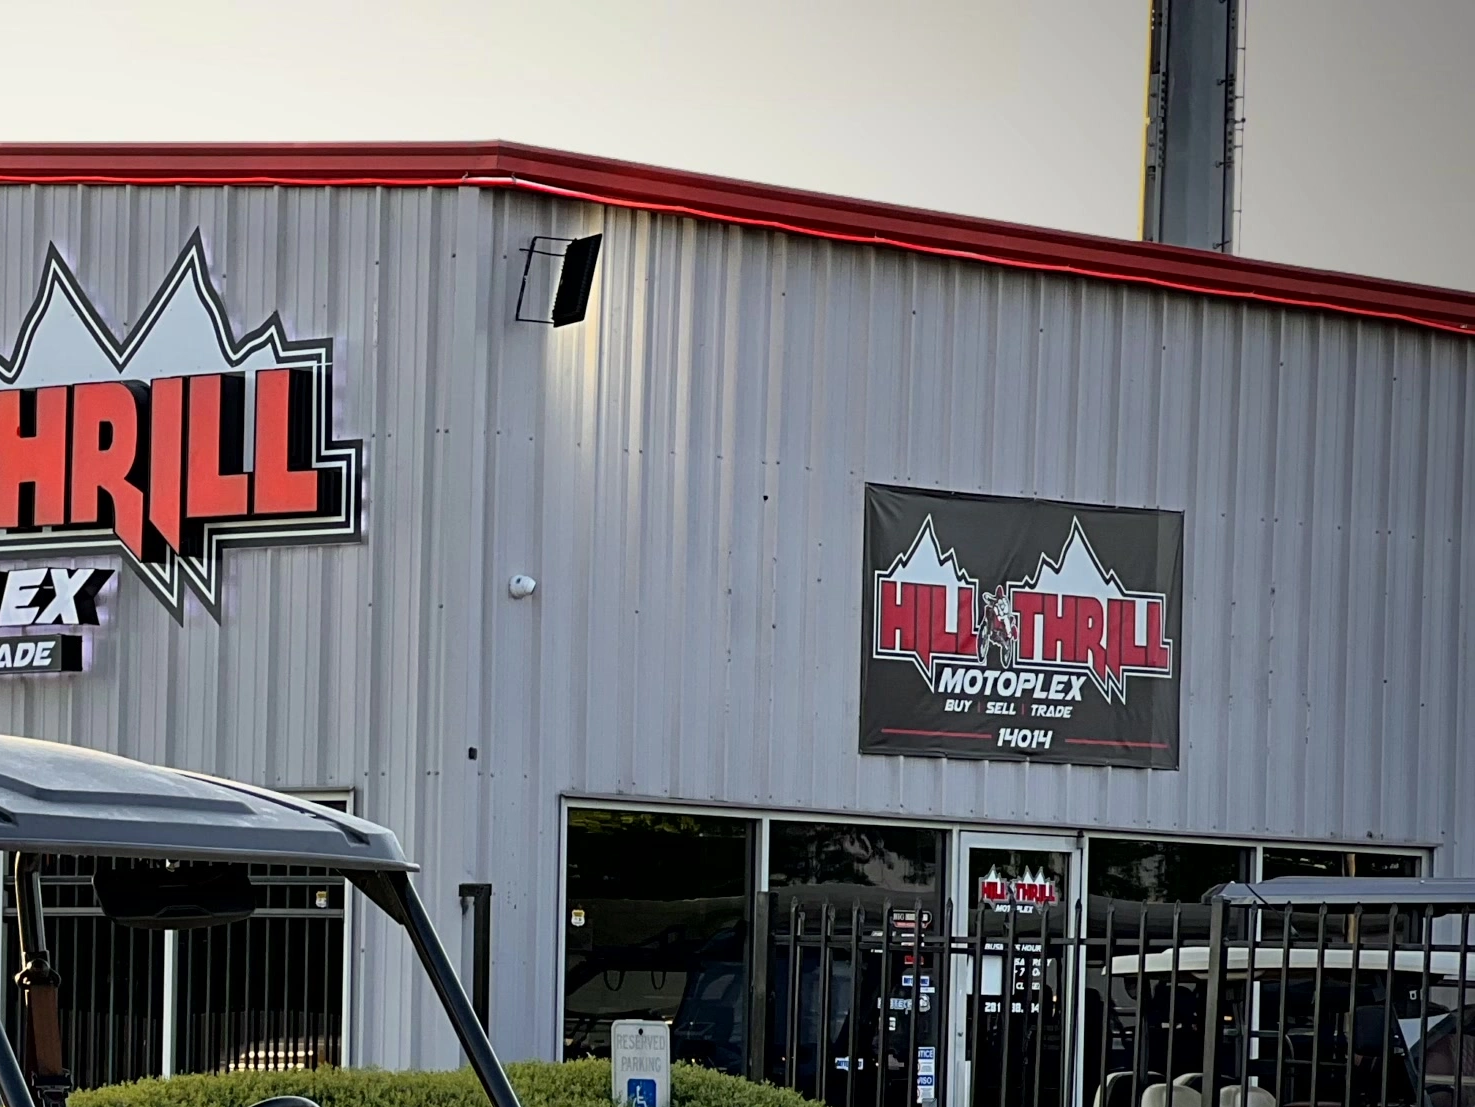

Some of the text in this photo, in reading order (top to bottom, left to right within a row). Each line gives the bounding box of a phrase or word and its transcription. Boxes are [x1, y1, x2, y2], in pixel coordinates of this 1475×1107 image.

[880, 580, 1170, 682] HILL THRILL
[938, 667, 1087, 701] MOTOPLEX
[944, 699, 1073, 718] BUY SELL TRADE
[997, 727, 1054, 749] 14014
[981, 881, 1056, 905] HILL THRILL
[995, 904, 1034, 913] MOTPLEX
[616, 1033, 666, 1051] RESERVED
[621, 1056, 662, 1073] PARKING
